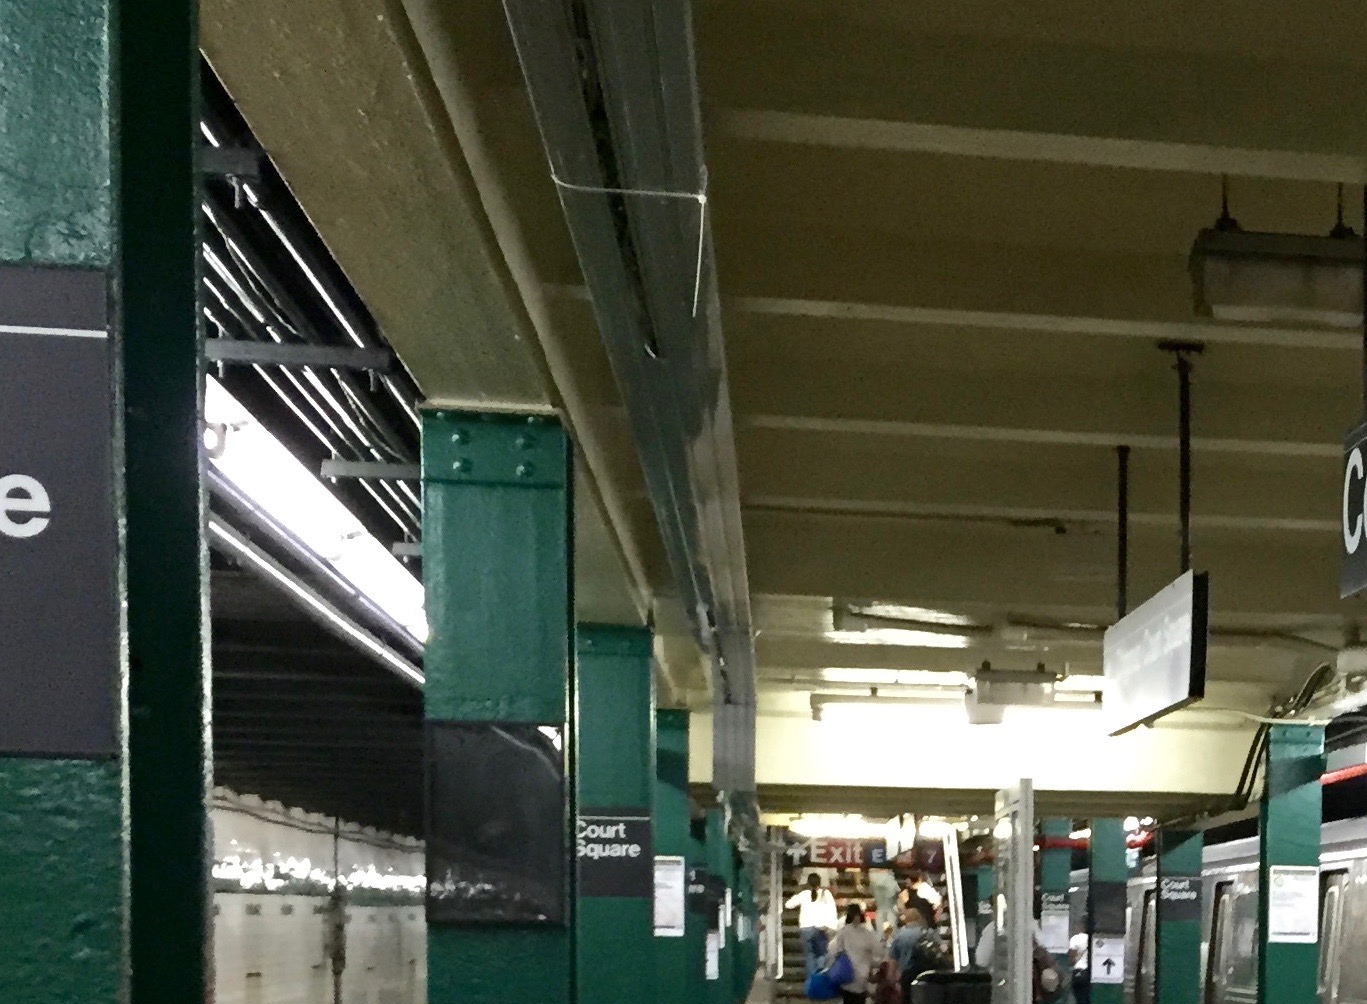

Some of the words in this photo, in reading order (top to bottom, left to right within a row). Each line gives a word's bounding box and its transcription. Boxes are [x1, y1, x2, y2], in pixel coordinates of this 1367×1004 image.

[577, 820, 627, 839] Court
[577, 839, 641, 860] Square
[810, 838, 864, 864] Exit
